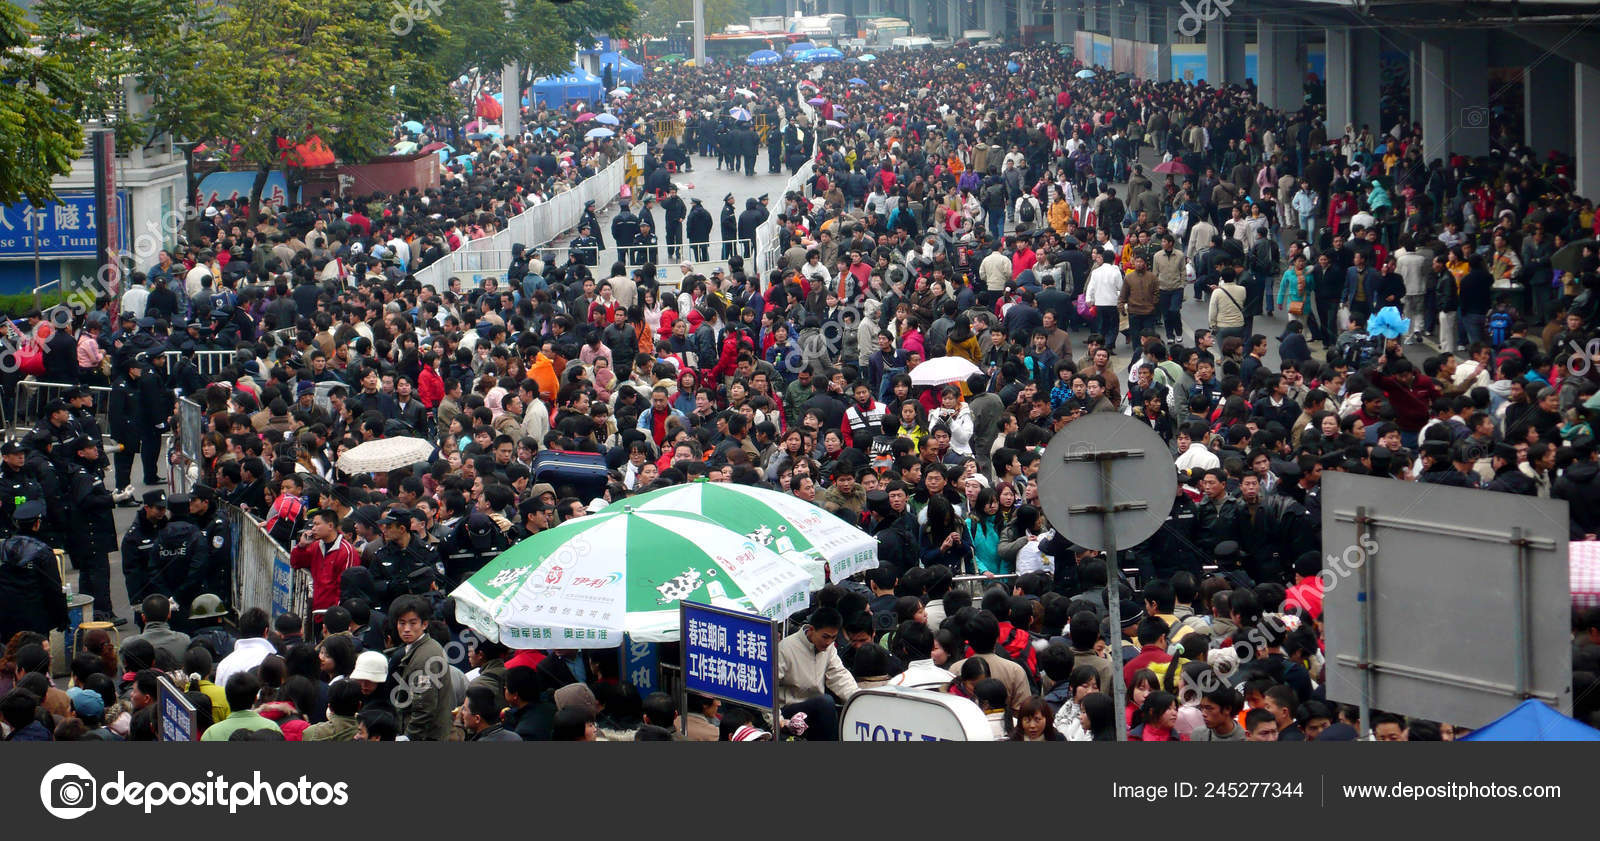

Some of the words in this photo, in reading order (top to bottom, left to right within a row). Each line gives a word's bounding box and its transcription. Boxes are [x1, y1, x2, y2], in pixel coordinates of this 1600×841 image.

[564, 627, 607, 640] 奥运标准
[689, 653, 768, 696] 工作车辆不得进入
